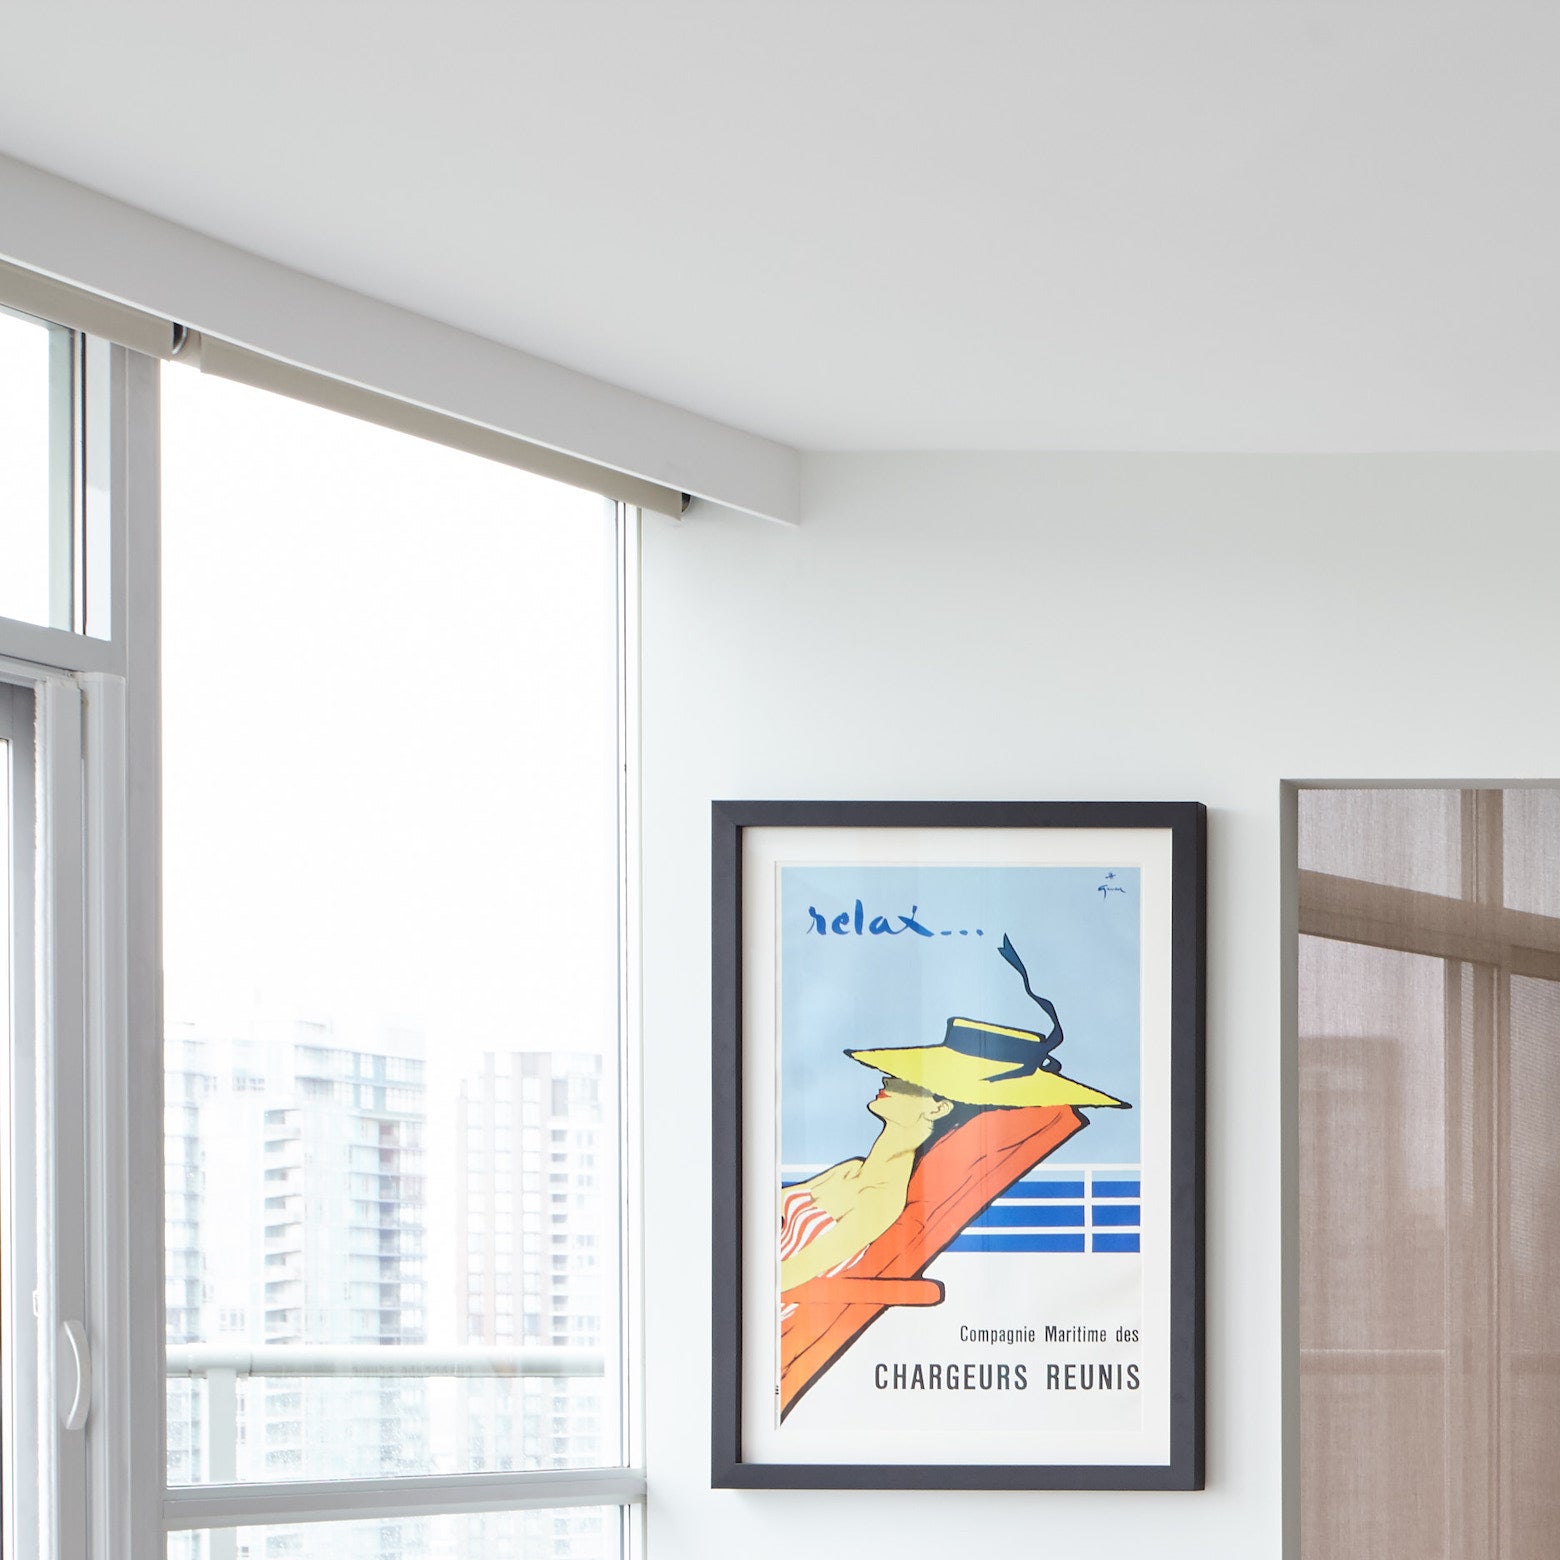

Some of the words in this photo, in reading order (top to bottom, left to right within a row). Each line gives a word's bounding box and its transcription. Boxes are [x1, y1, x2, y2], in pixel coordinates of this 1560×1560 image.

[960, 1325, 1036, 1345] Compagnie
[1045, 1325, 1107, 1343] Maritime
[1116, 1325, 1140, 1343] des
[874, 1363, 1029, 1391] CHARGEURS
[1046, 1363, 1141, 1391] REUNIS
